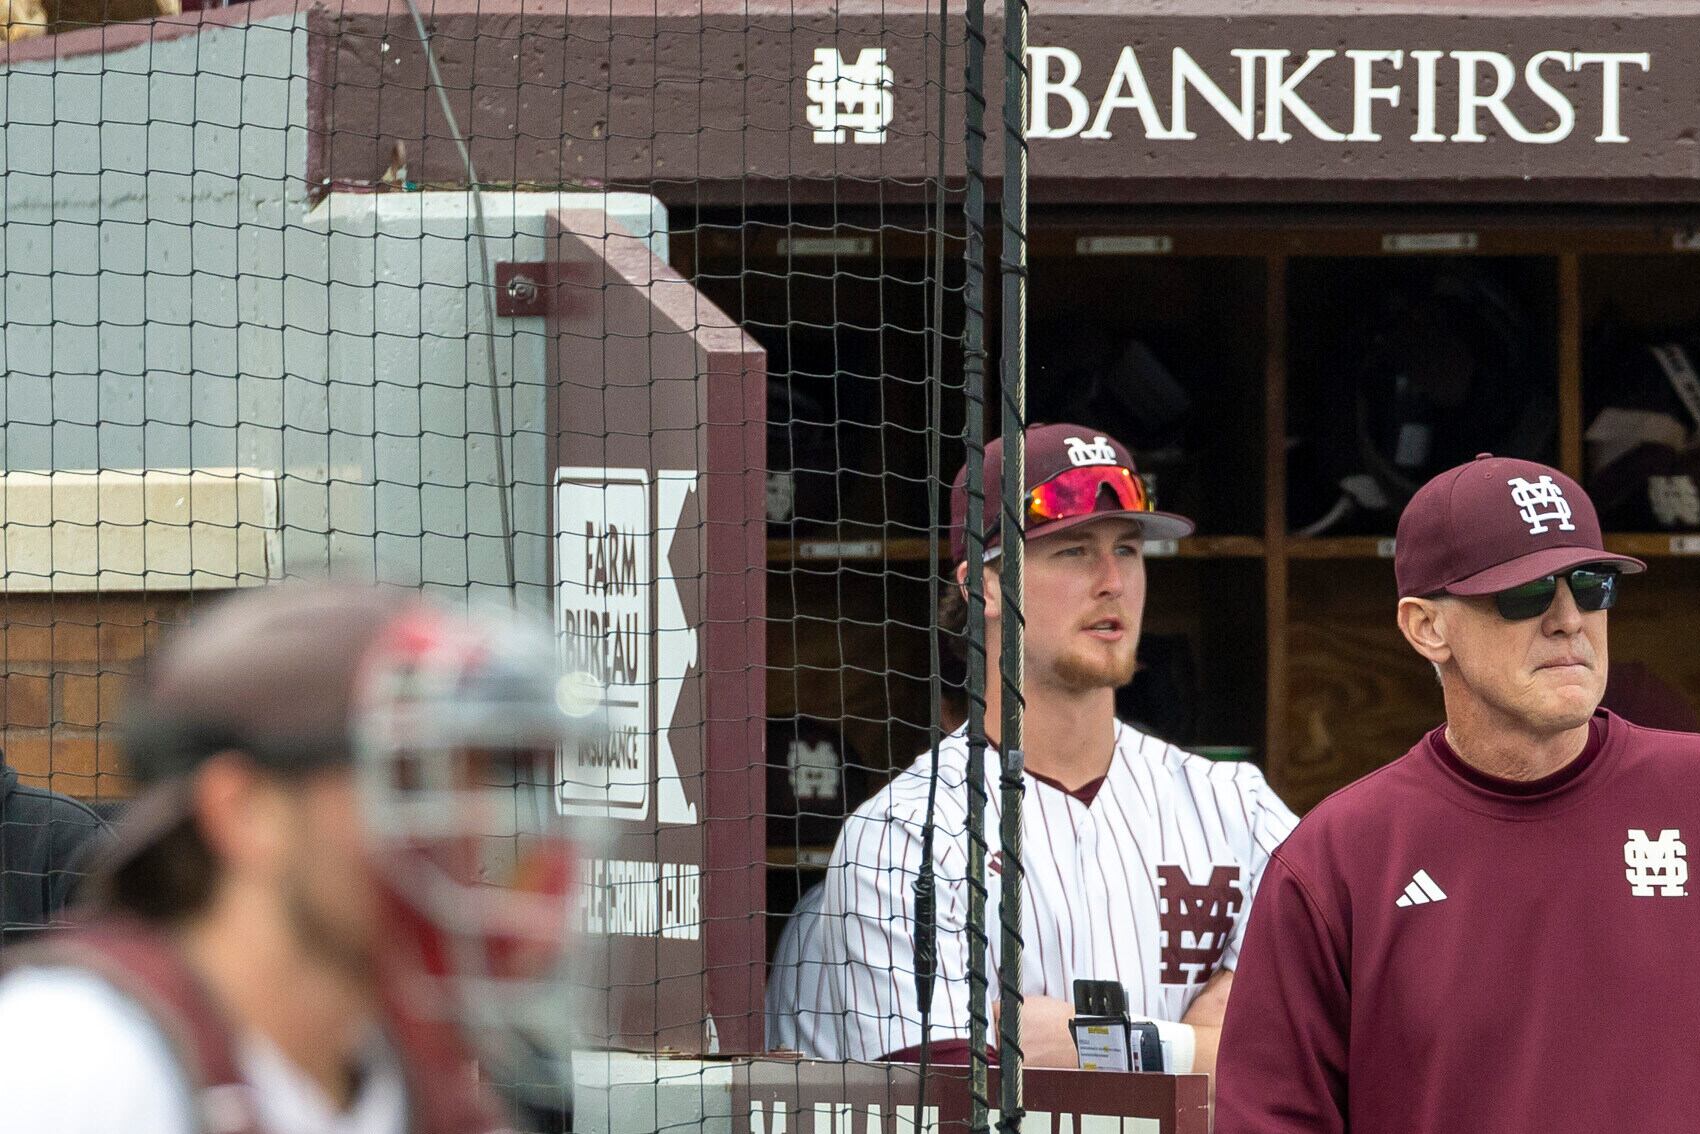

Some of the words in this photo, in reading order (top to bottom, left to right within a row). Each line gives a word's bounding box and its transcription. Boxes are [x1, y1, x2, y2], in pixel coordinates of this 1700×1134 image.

[1025, 45, 1651, 144] BANKFIRST
[585, 521, 638, 597] FARM
[566, 609, 639, 685] BUREAU
[662, 863, 700, 941] CLUB
